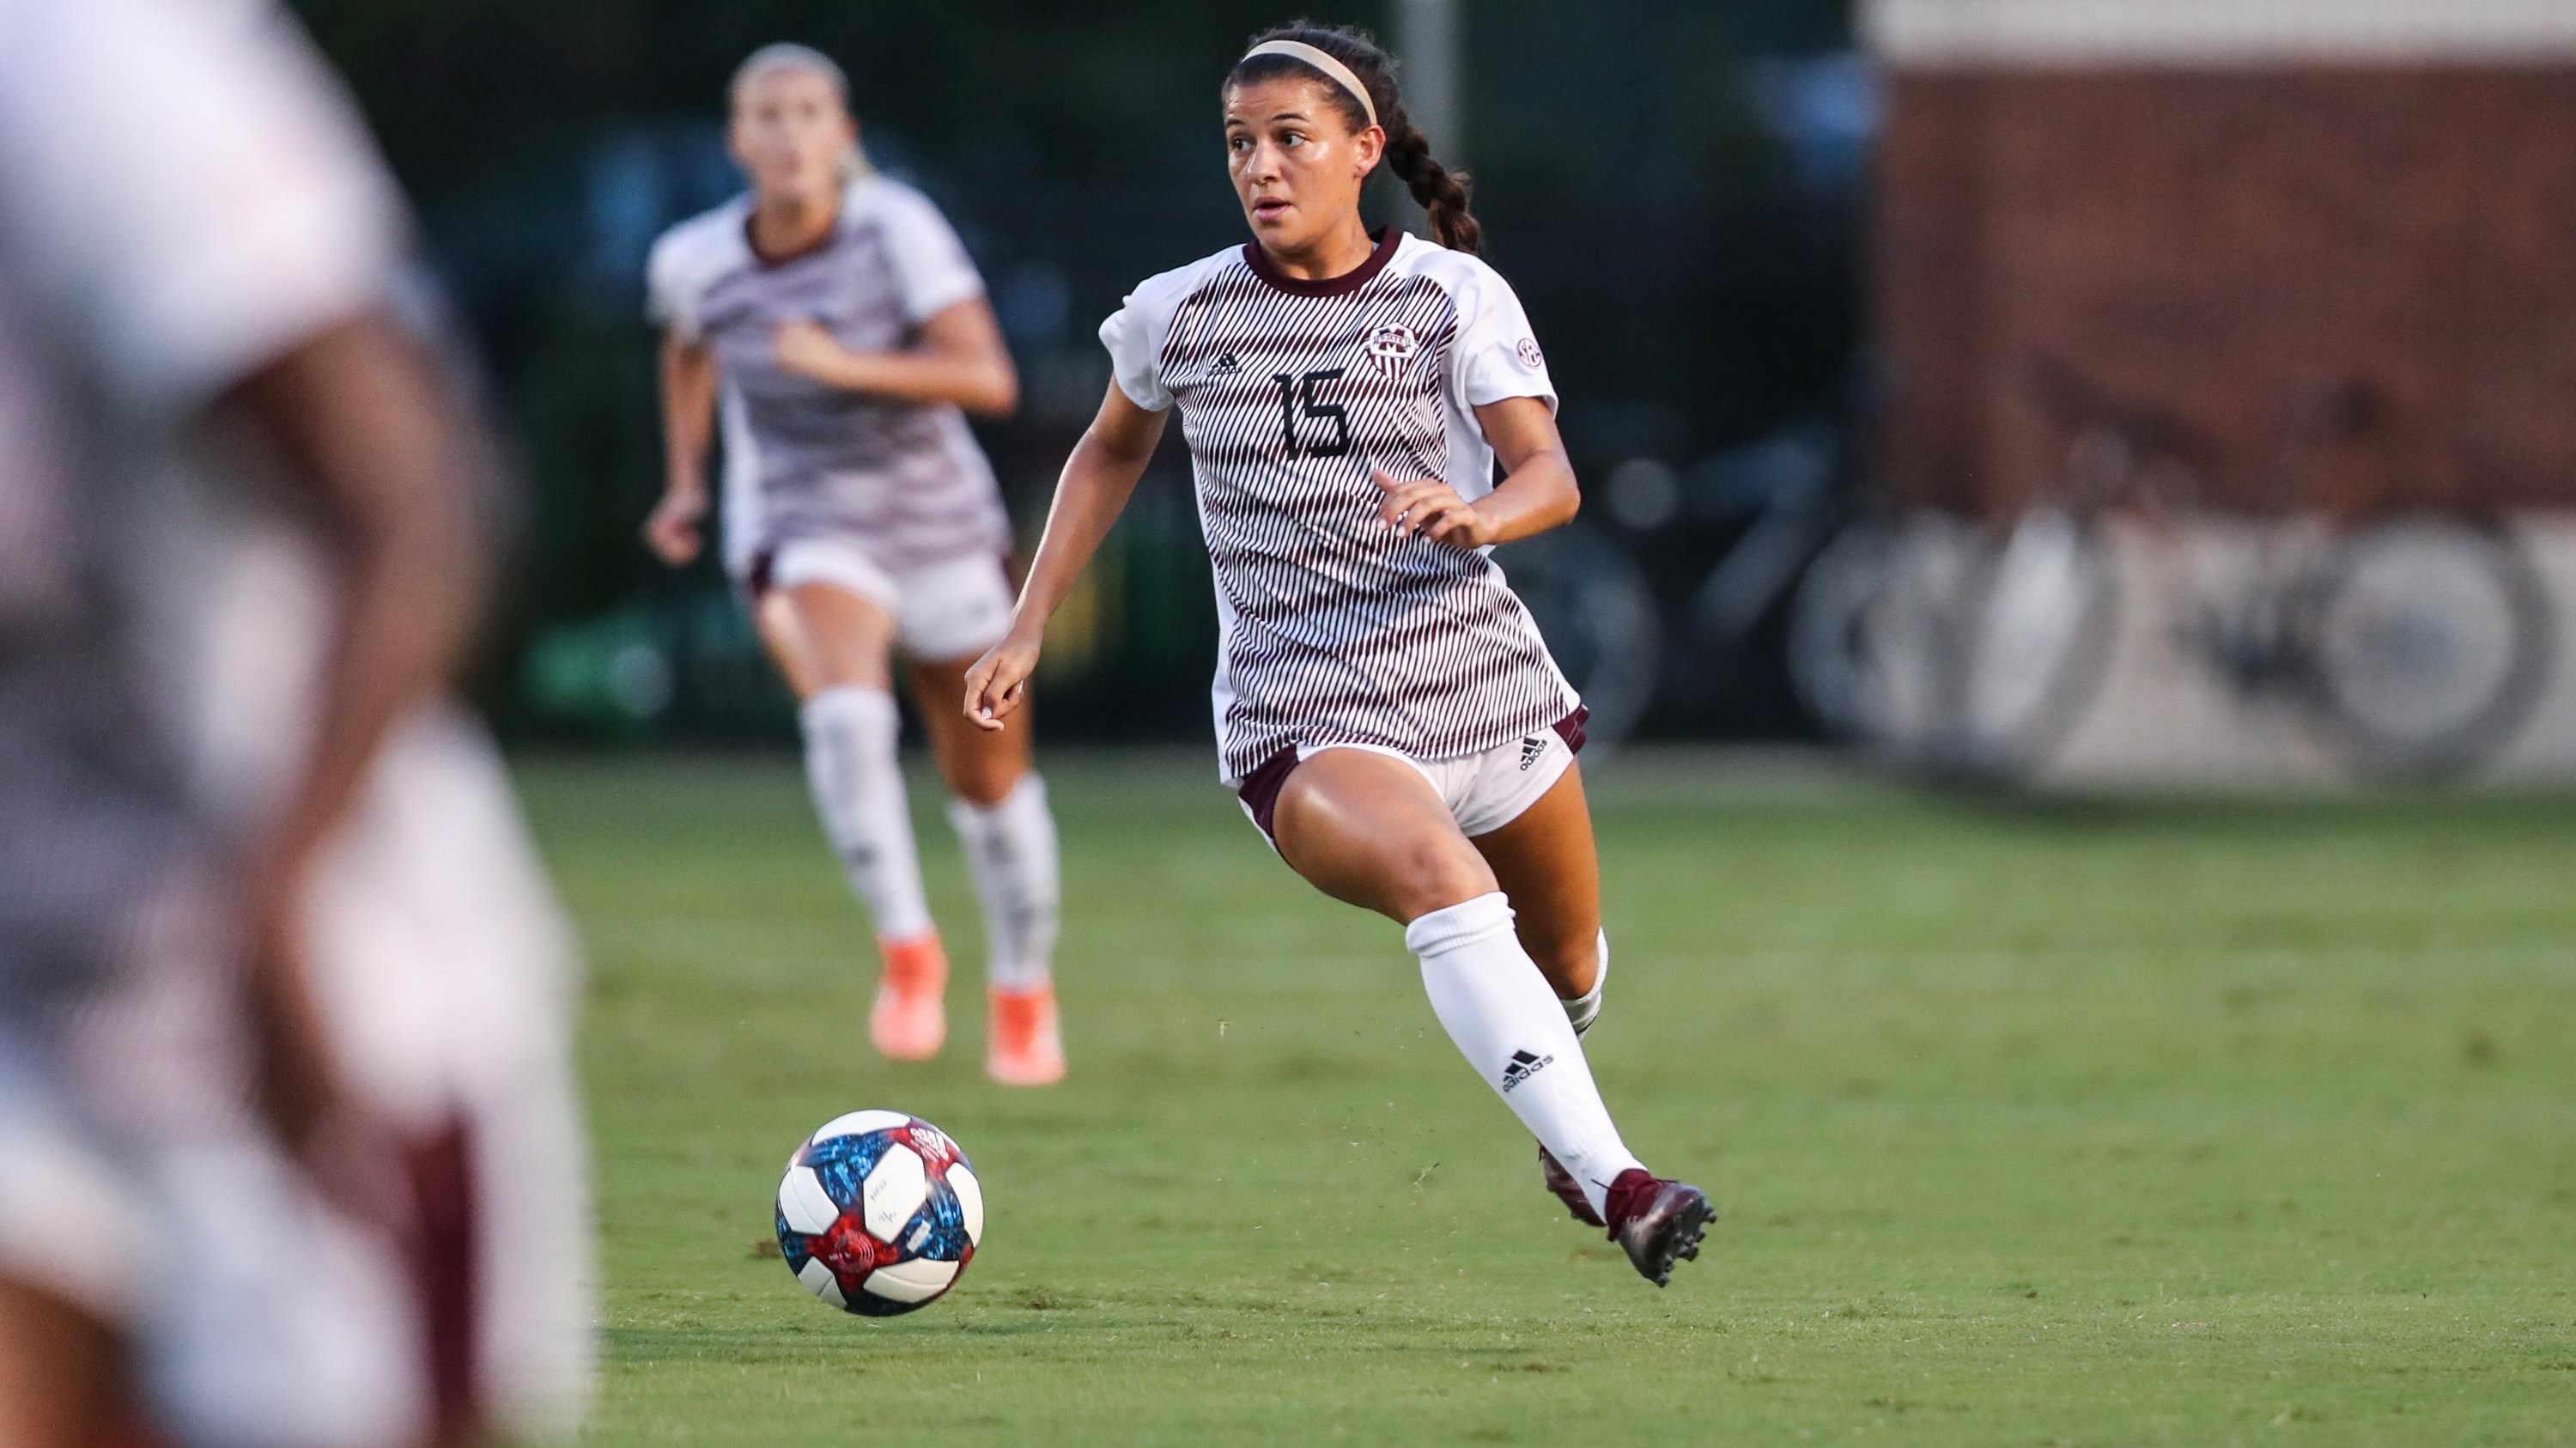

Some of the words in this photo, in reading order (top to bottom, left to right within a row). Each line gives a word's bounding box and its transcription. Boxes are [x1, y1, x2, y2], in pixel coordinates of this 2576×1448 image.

[1381, 334, 1402, 344] STATE
[1272, 367, 1351, 461] 15
[1520, 739, 1546, 770] adidas
[1502, 1054, 1553, 1092] adidas
